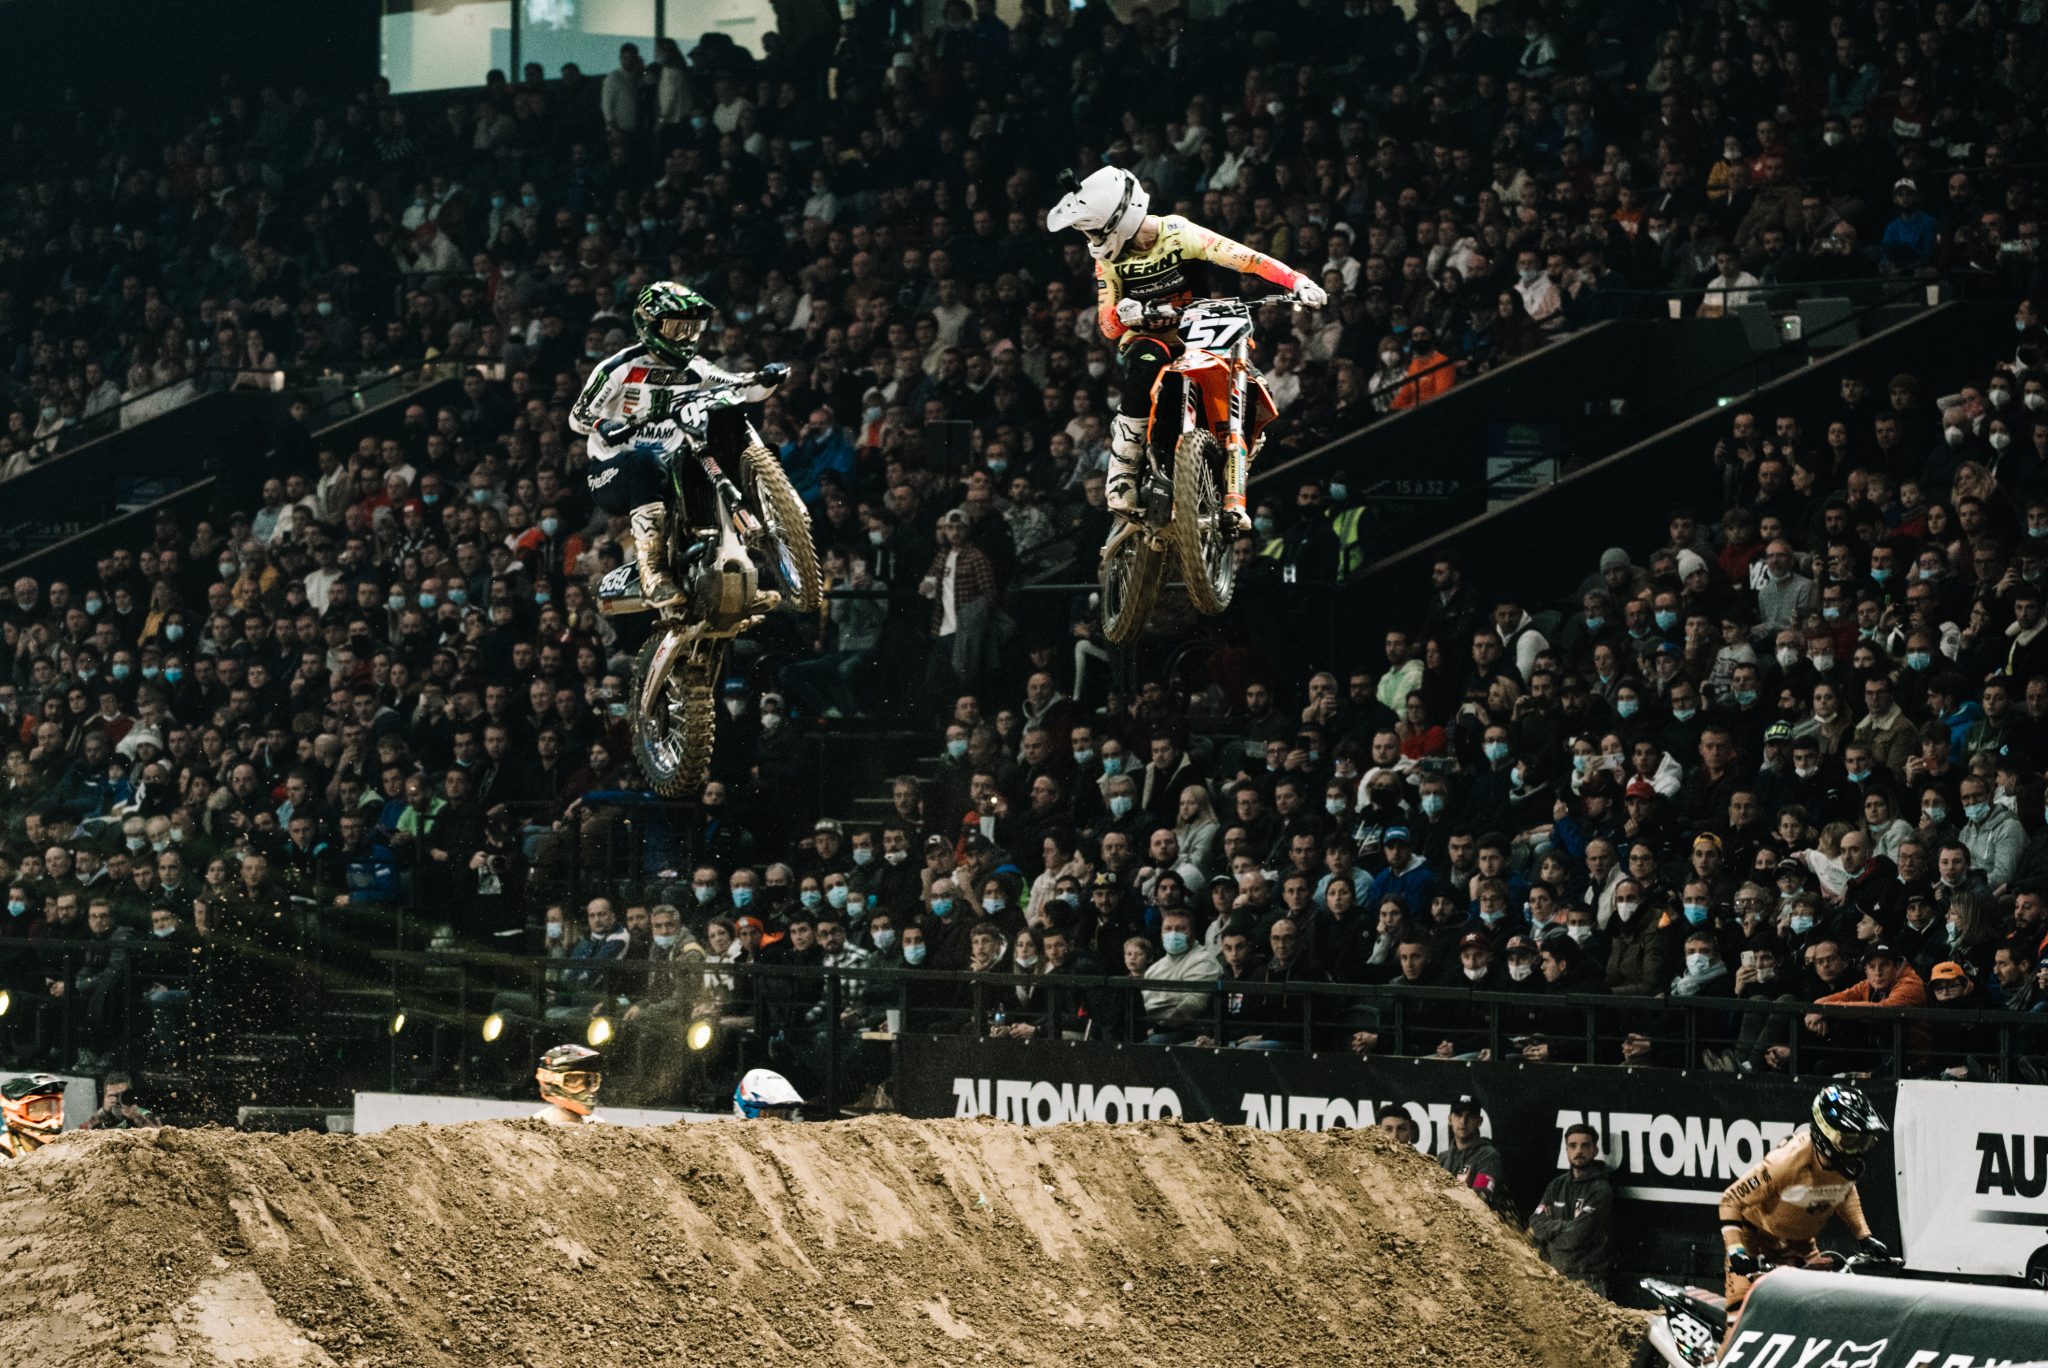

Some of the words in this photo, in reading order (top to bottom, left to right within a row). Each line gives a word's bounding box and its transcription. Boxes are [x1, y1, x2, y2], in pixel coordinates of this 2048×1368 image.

[1114, 247, 1184, 280] KENNY
[1185, 316, 1249, 349] 57
[635, 426, 675, 439] AMAH
[953, 1077, 1183, 1127] AUTOMOTO
[1555, 1108, 1811, 1180] AUTOMOT
[1975, 1132, 2048, 1198] AU
